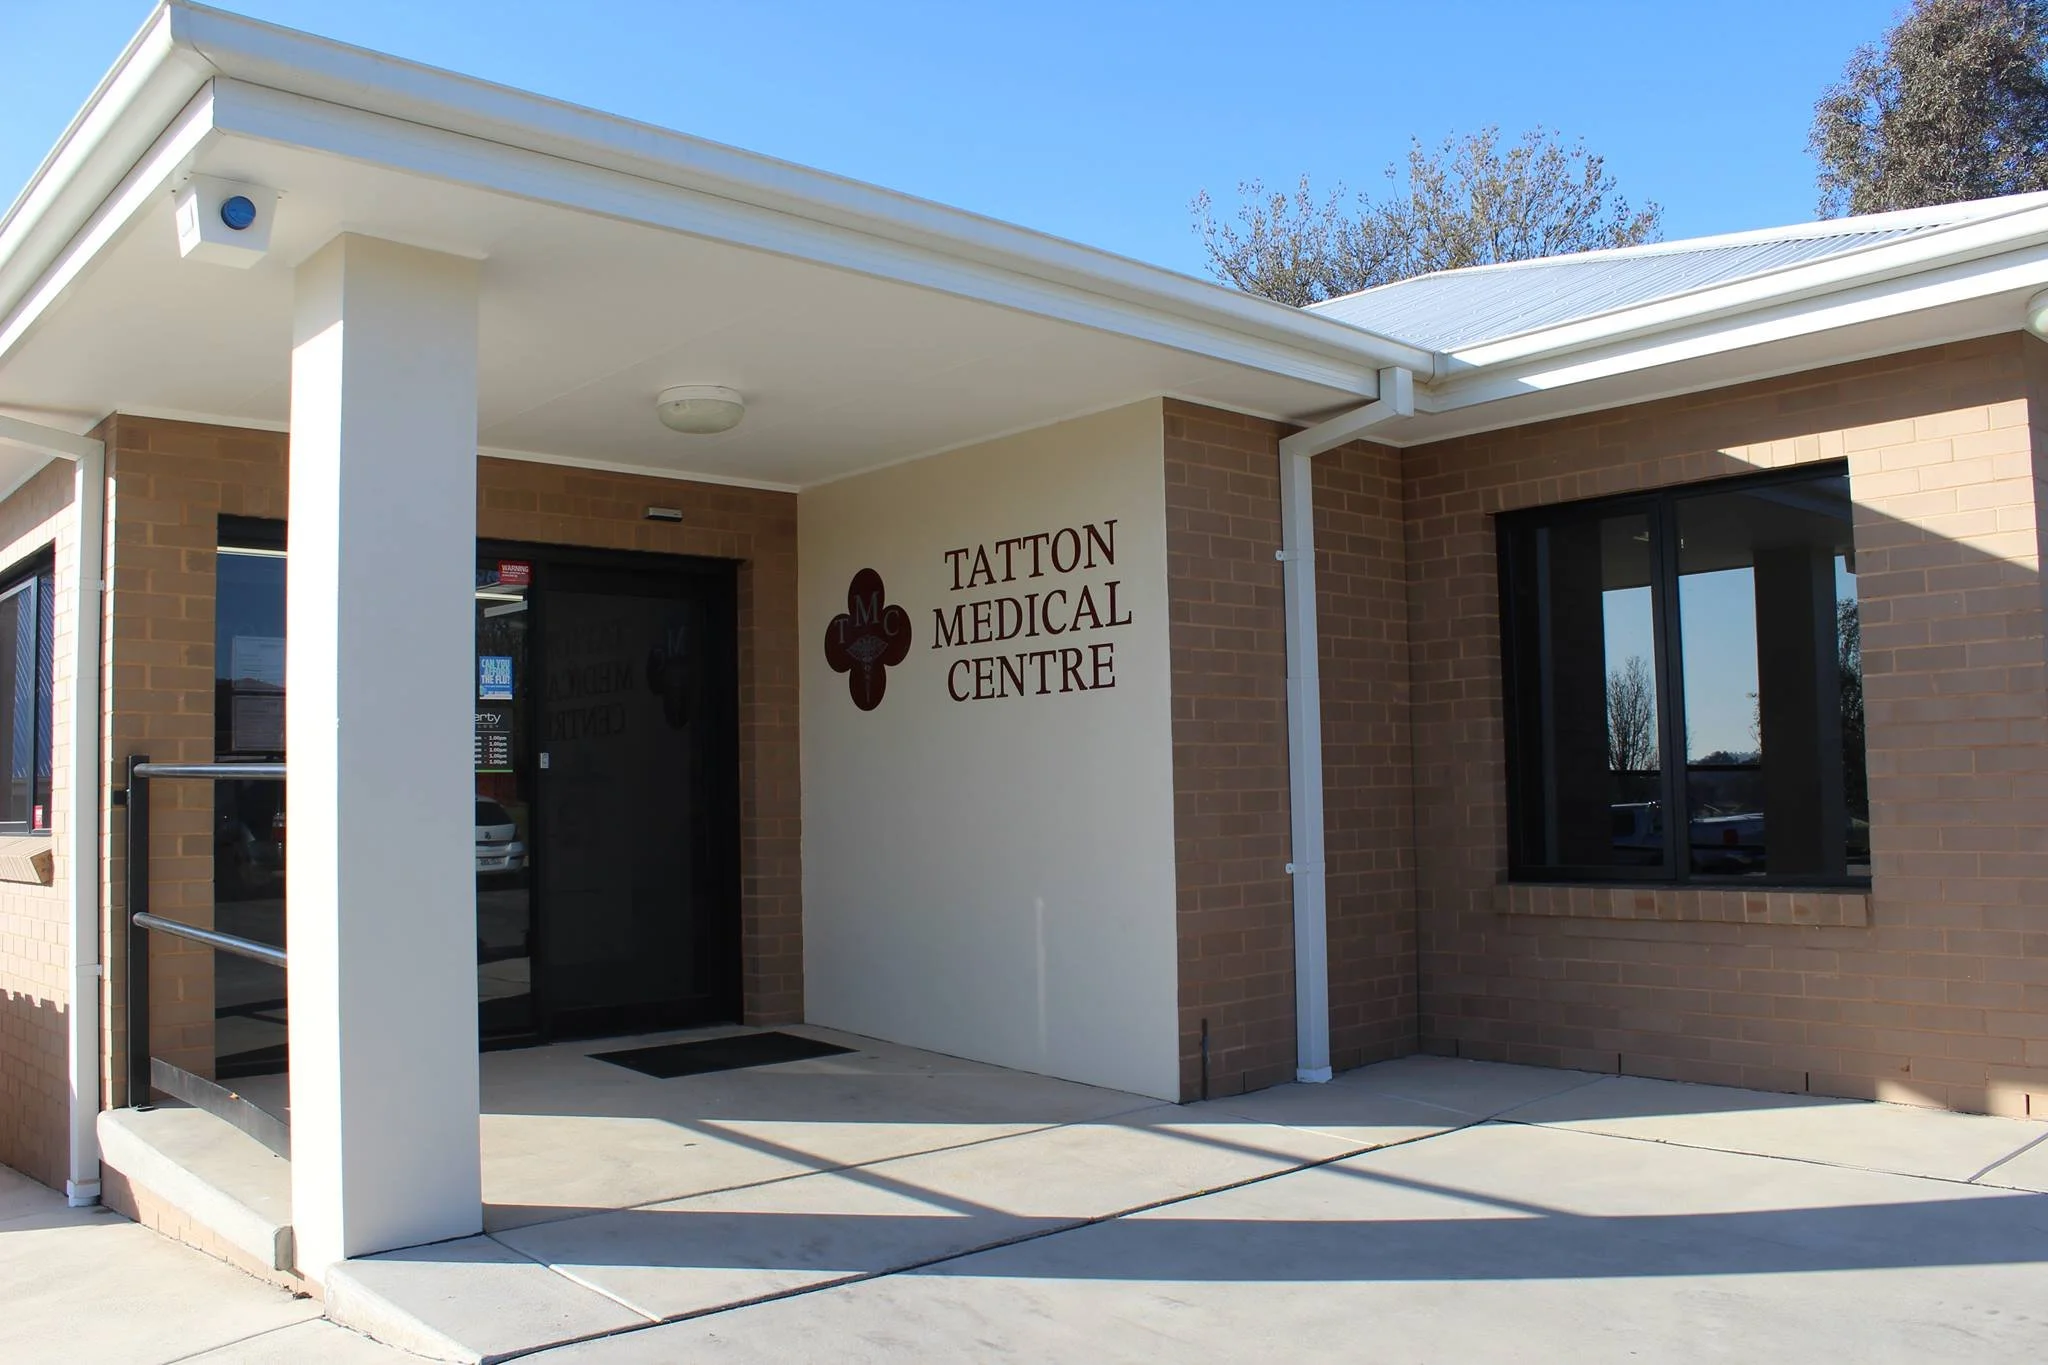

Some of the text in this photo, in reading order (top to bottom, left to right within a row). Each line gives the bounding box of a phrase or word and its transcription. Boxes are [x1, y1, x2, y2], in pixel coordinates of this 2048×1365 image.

[501, 564, 528, 572] WARNING
[945, 519, 1118, 591] TATTON
[931, 580, 1132, 649] MEDICAL
[481, 675, 494, 684] THE
[947, 642, 1116, 702] CENTRE
